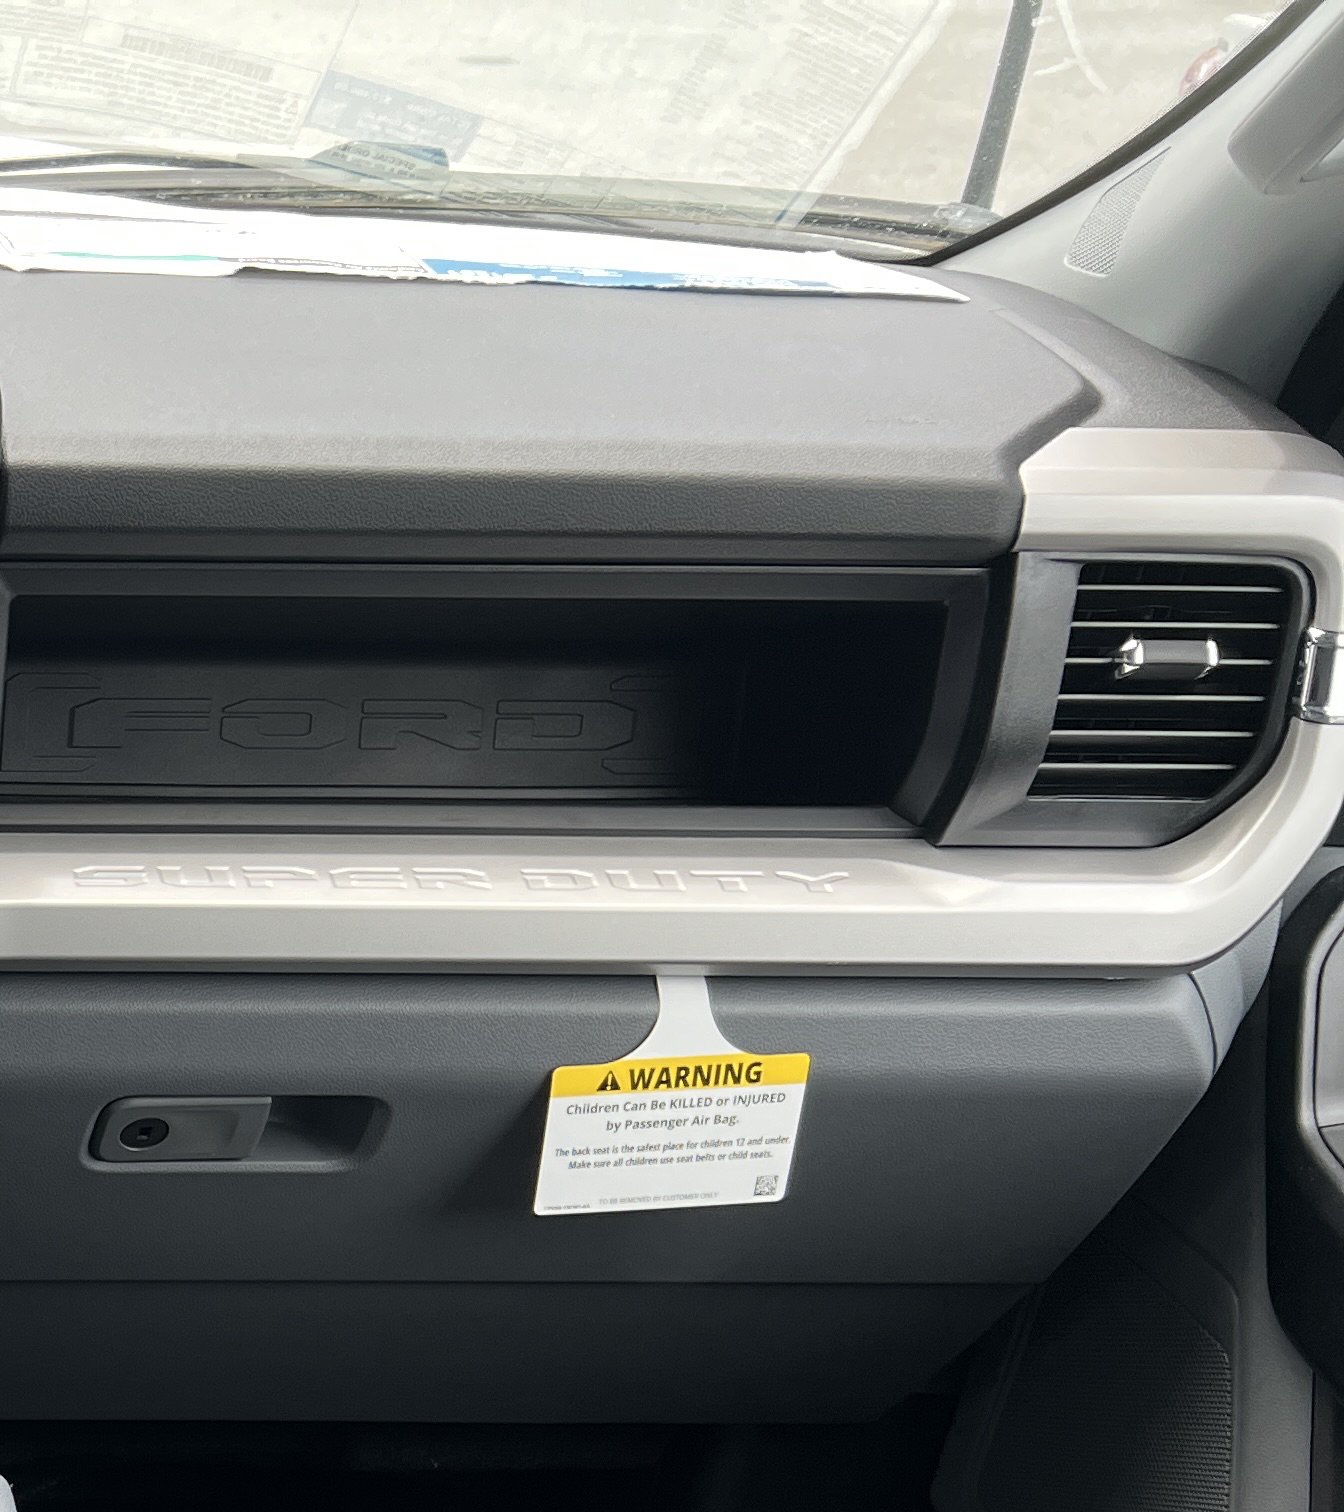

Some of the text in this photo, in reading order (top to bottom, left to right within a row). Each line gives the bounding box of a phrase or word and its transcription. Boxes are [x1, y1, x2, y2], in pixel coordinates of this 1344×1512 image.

[68, 697, 637, 750] FORD
[72, 865, 851, 895] SUPER DUTY
[629, 1062, 763, 1091] WARNING
[566, 1093, 787, 1116] Children Can Be KILLED or INJURED
[605, 1114, 740, 1133] by Passenger Air Bag.
[555, 1148, 570, 1157] The
[572, 1147, 591, 1156] back
[593, 1146, 610, 1155] seat
[612, 1145, 619, 1153] is
[621, 1144, 634, 1153] the
[637, 1143, 661, 1152] safest
[662, 1141, 685, 1153] place
[685, 1140, 699, 1149] for
[700, 1139, 733, 1149] children
[747, 1137, 763, 1146] and
[765, 1135, 791, 1145] under.
[568, 1160, 592, 1169] Make
[593, 1160, 611, 1168] sure
[613, 1158, 624, 1167] all
[625, 1157, 658, 1166] children
[676, 1154, 693, 1163] seat
[695, 1152, 715, 1162] belts
[728, 1150, 748, 1160] child
[750, 1150, 773, 1159] seats.
